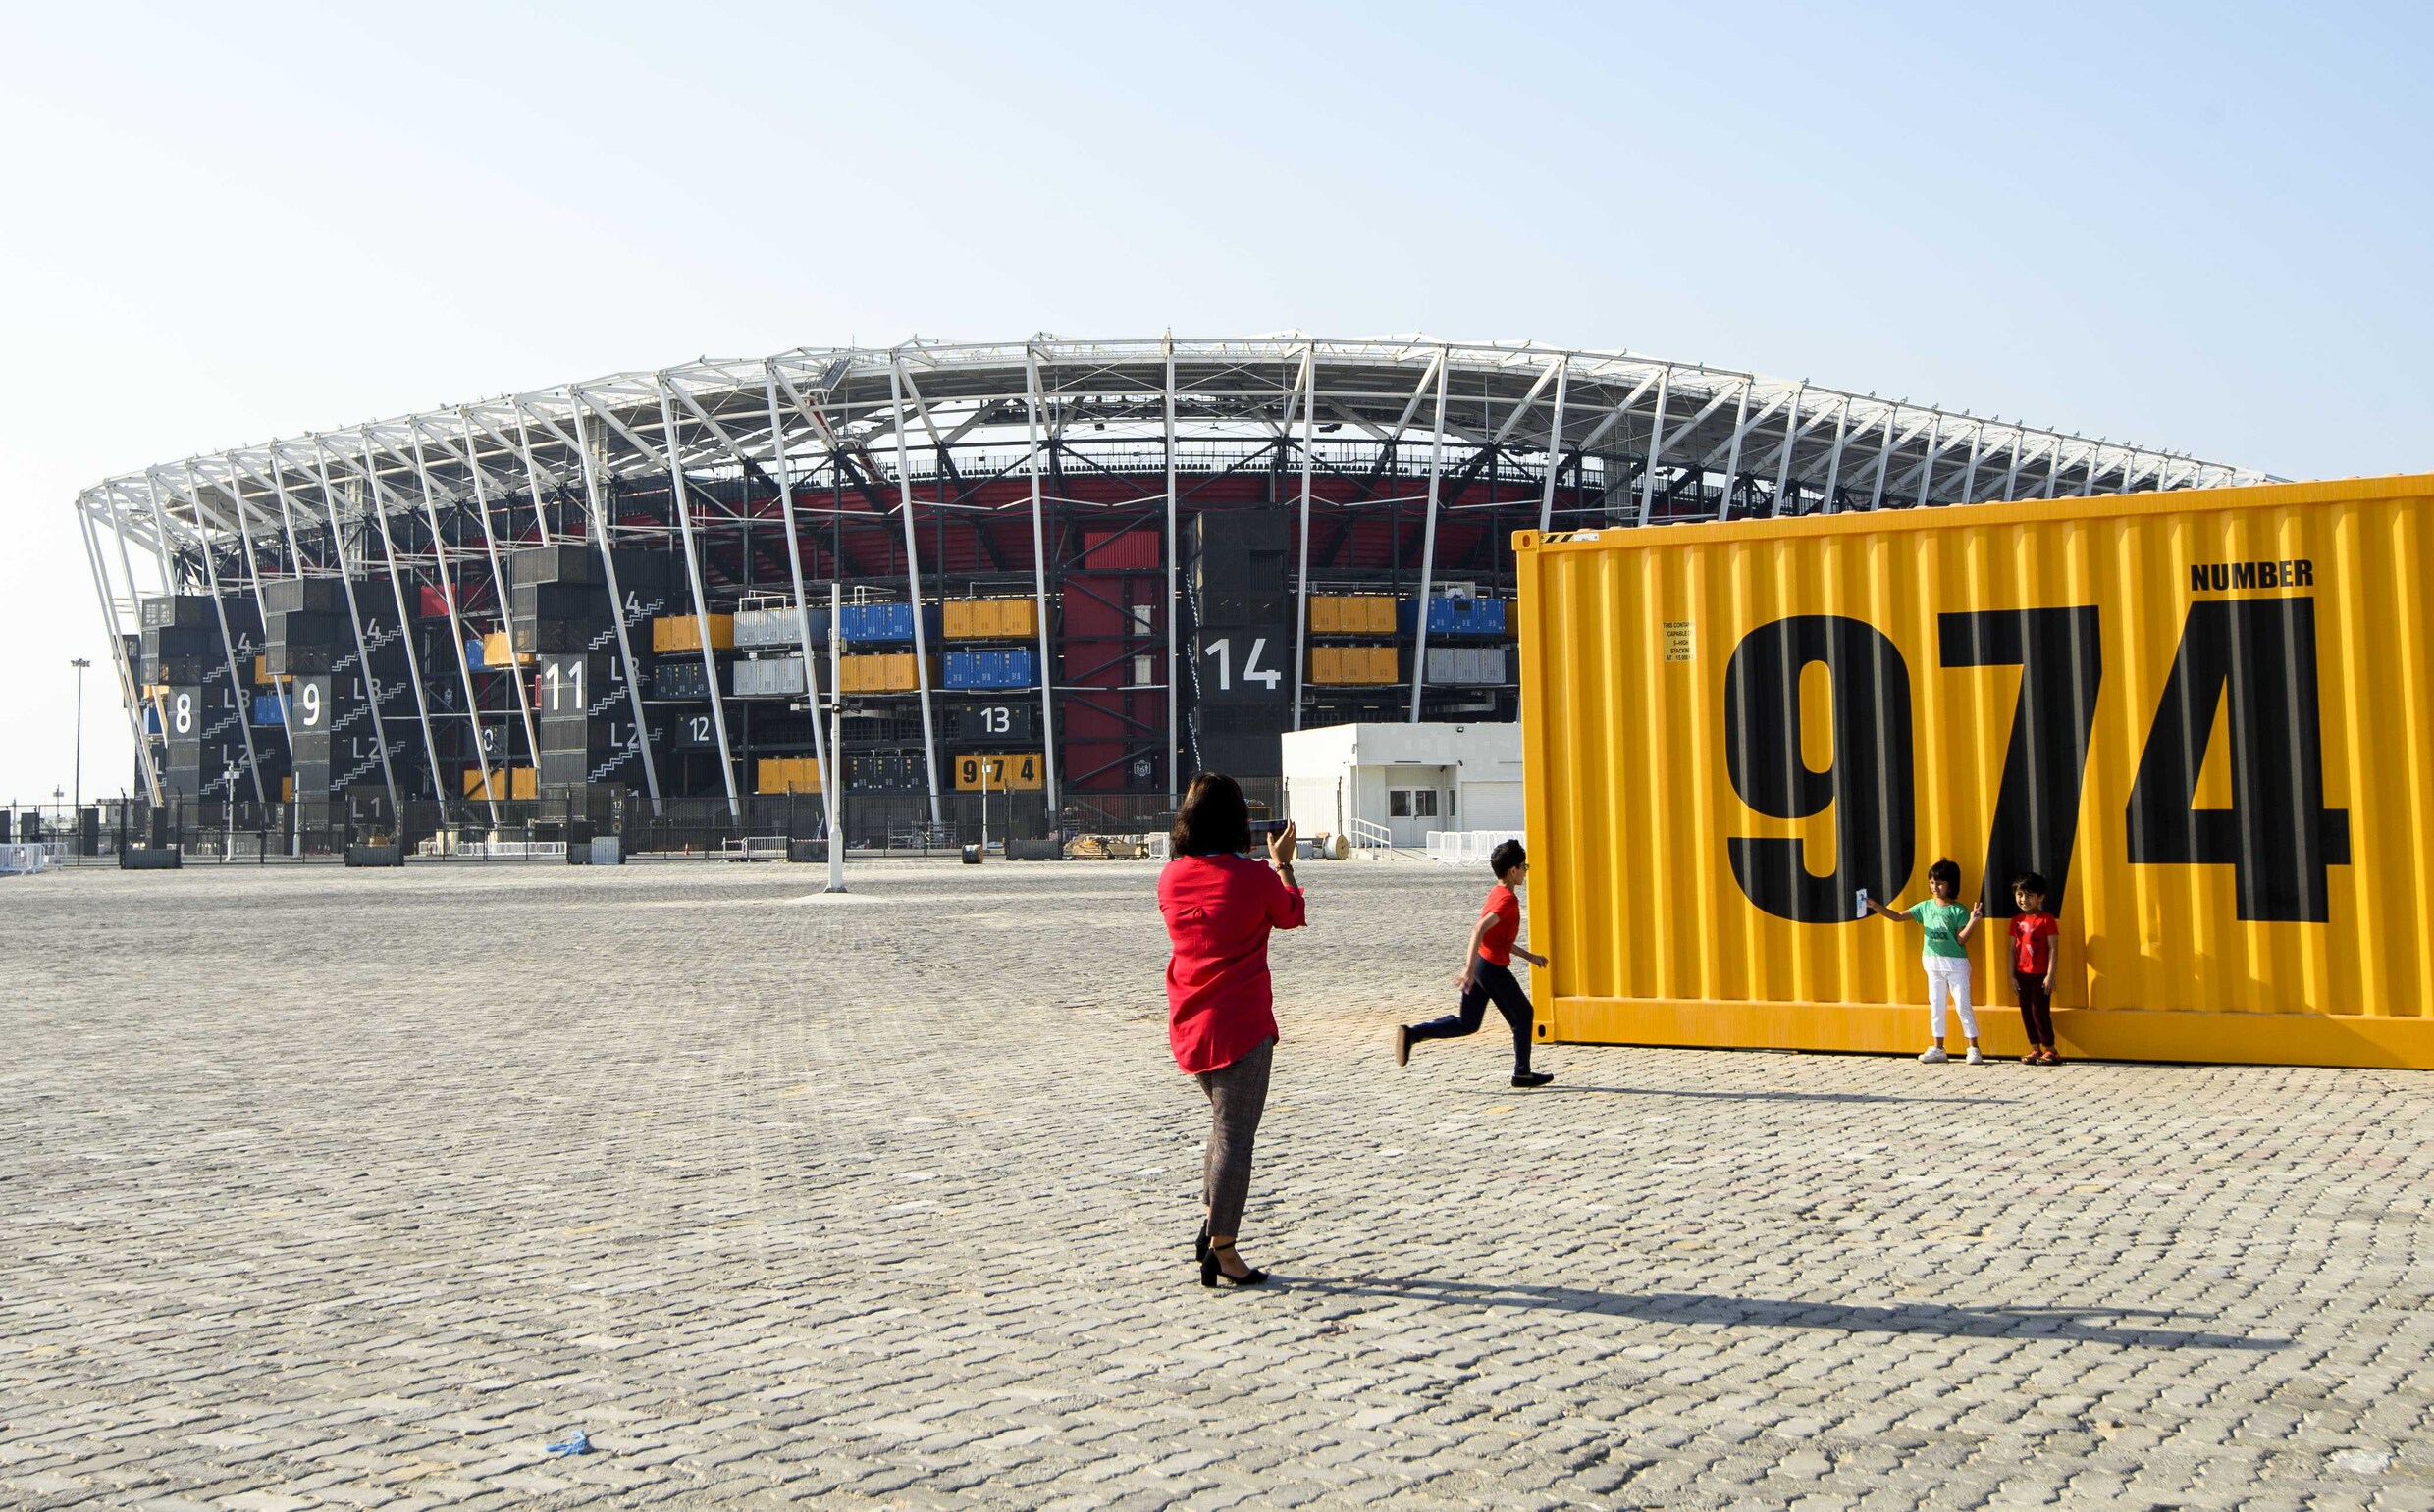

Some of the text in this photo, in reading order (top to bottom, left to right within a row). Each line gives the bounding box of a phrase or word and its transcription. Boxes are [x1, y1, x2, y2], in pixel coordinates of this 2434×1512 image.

[2191, 560, 2313, 591] NUMBER
[1205, 638, 1281, 690] 14
[545, 661, 583, 710] 11
[176, 693, 192, 733] 8
[302, 683, 321, 726] 9
[689, 717, 709, 742] 12
[980, 706, 1010, 733] 13
[352, 737, 382, 758] L2
[610, 722, 640, 747] L2
[223, 744, 250, 764] L2
[1724, 596, 2352, 923] 974
[351, 797, 380, 818] L1
[1930, 931, 1949, 940] COOL
